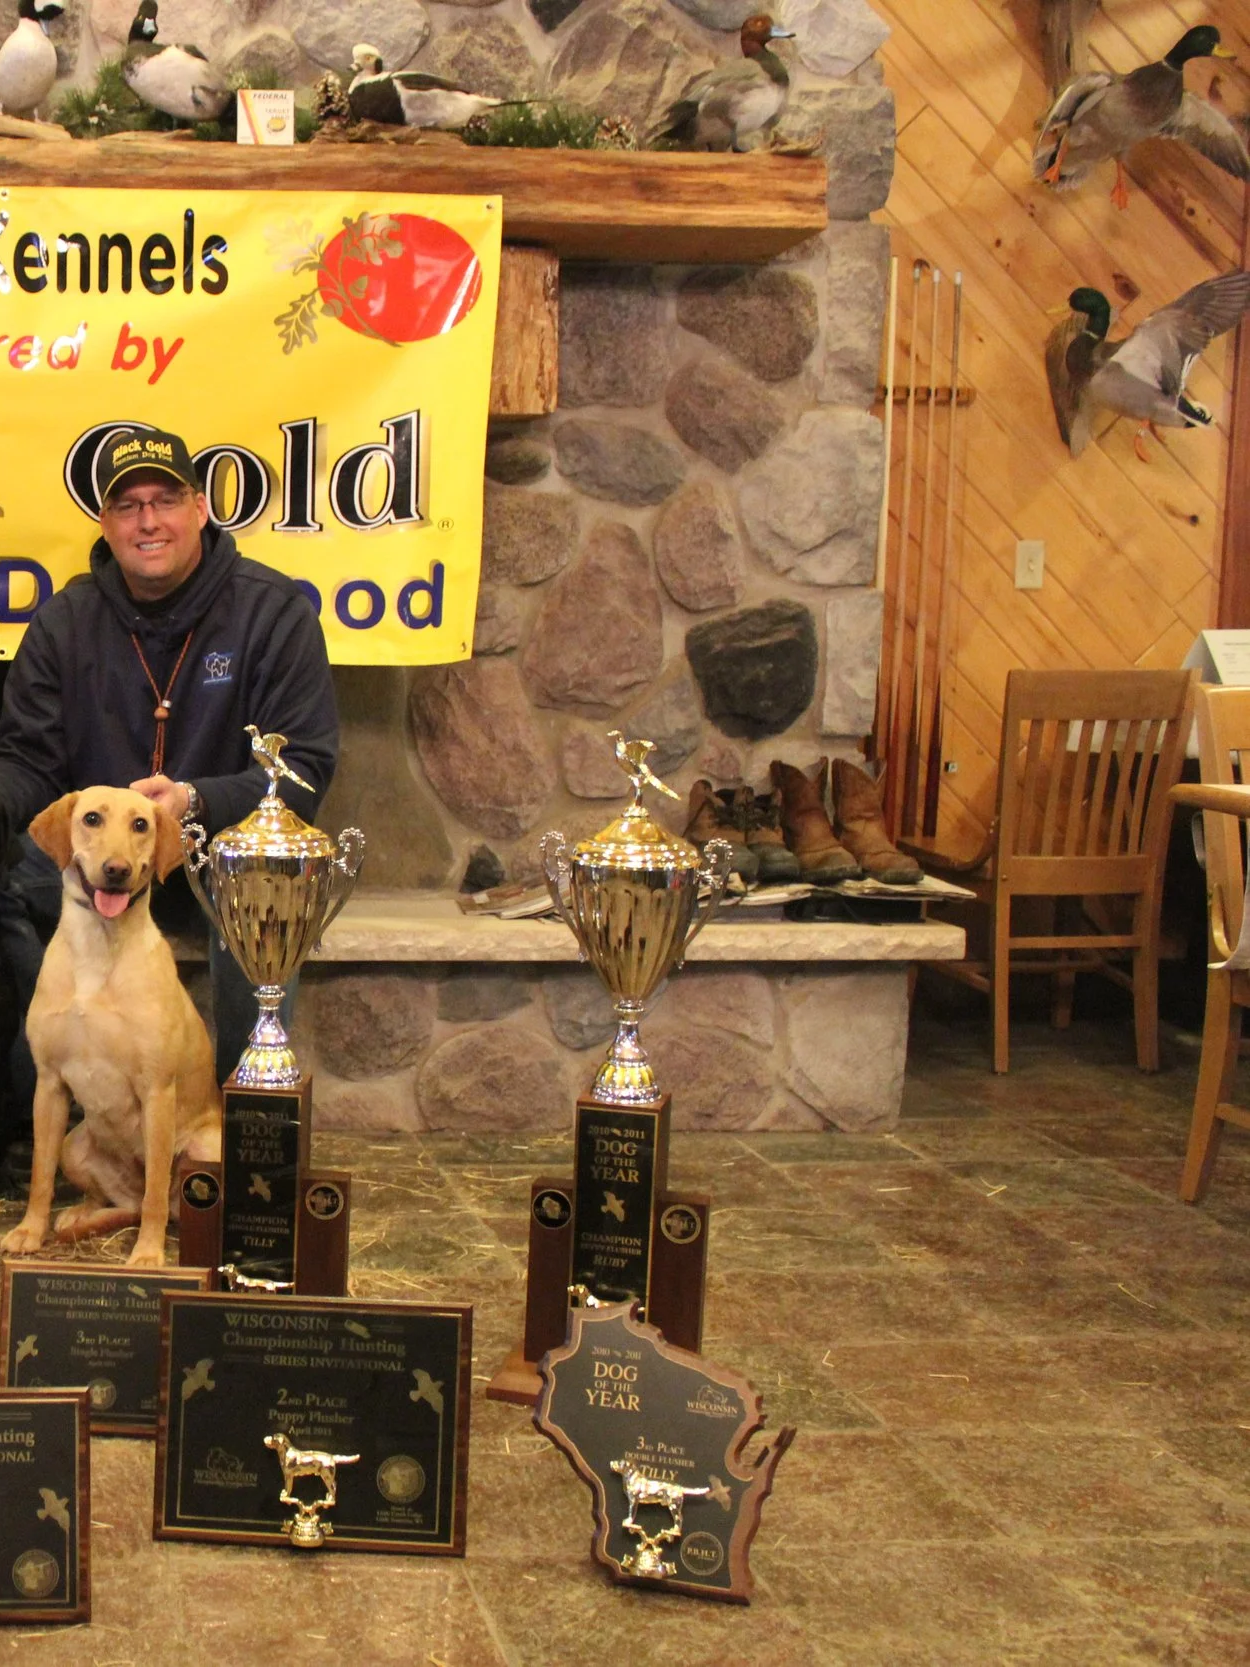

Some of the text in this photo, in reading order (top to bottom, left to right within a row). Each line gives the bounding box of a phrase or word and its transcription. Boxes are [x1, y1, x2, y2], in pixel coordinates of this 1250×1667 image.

[111, 321, 185, 385] by
[113, 439, 172, 461] Black Gold
[242, 1123, 282, 1138] DOG
[623, 1128, 645, 1140] 2011
[595, 1139, 638, 1156] DOG
[237, 1148, 285, 1164] YEAR
[594, 1156, 637, 1168] OF THE
[590, 1167, 640, 1183] YEAR
[242, 1235, 276, 1248] TILLY
[593, 1253, 628, 1268] RUBY
[36, 1278, 117, 1293] WISCONSIN
[36, 1292, 160, 1310] Championship Hunti
[102, 1311, 160, 1323] INVITATION
[225, 1312, 330, 1331] WISCONSIN
[223, 1331, 406, 1357] Championship Hunting
[263, 1355, 405, 1372] SERIES INVITATIONAL
[593, 1361, 638, 1382] DOG
[594, 1380, 633, 1393] OF THE
[305, 1393, 347, 1408] PLACE
[585, 1388, 640, 1412] YEAR
[686, 1400, 738, 1415] WISCONSIN
[268, 1408, 355, 1424] Puppy Flusher
[657, 1442, 685, 1455] PLACE
[624, 1451, 695, 1468] DOUBLE FLUSHER
[639, 1464, 679, 1480] TILLY
